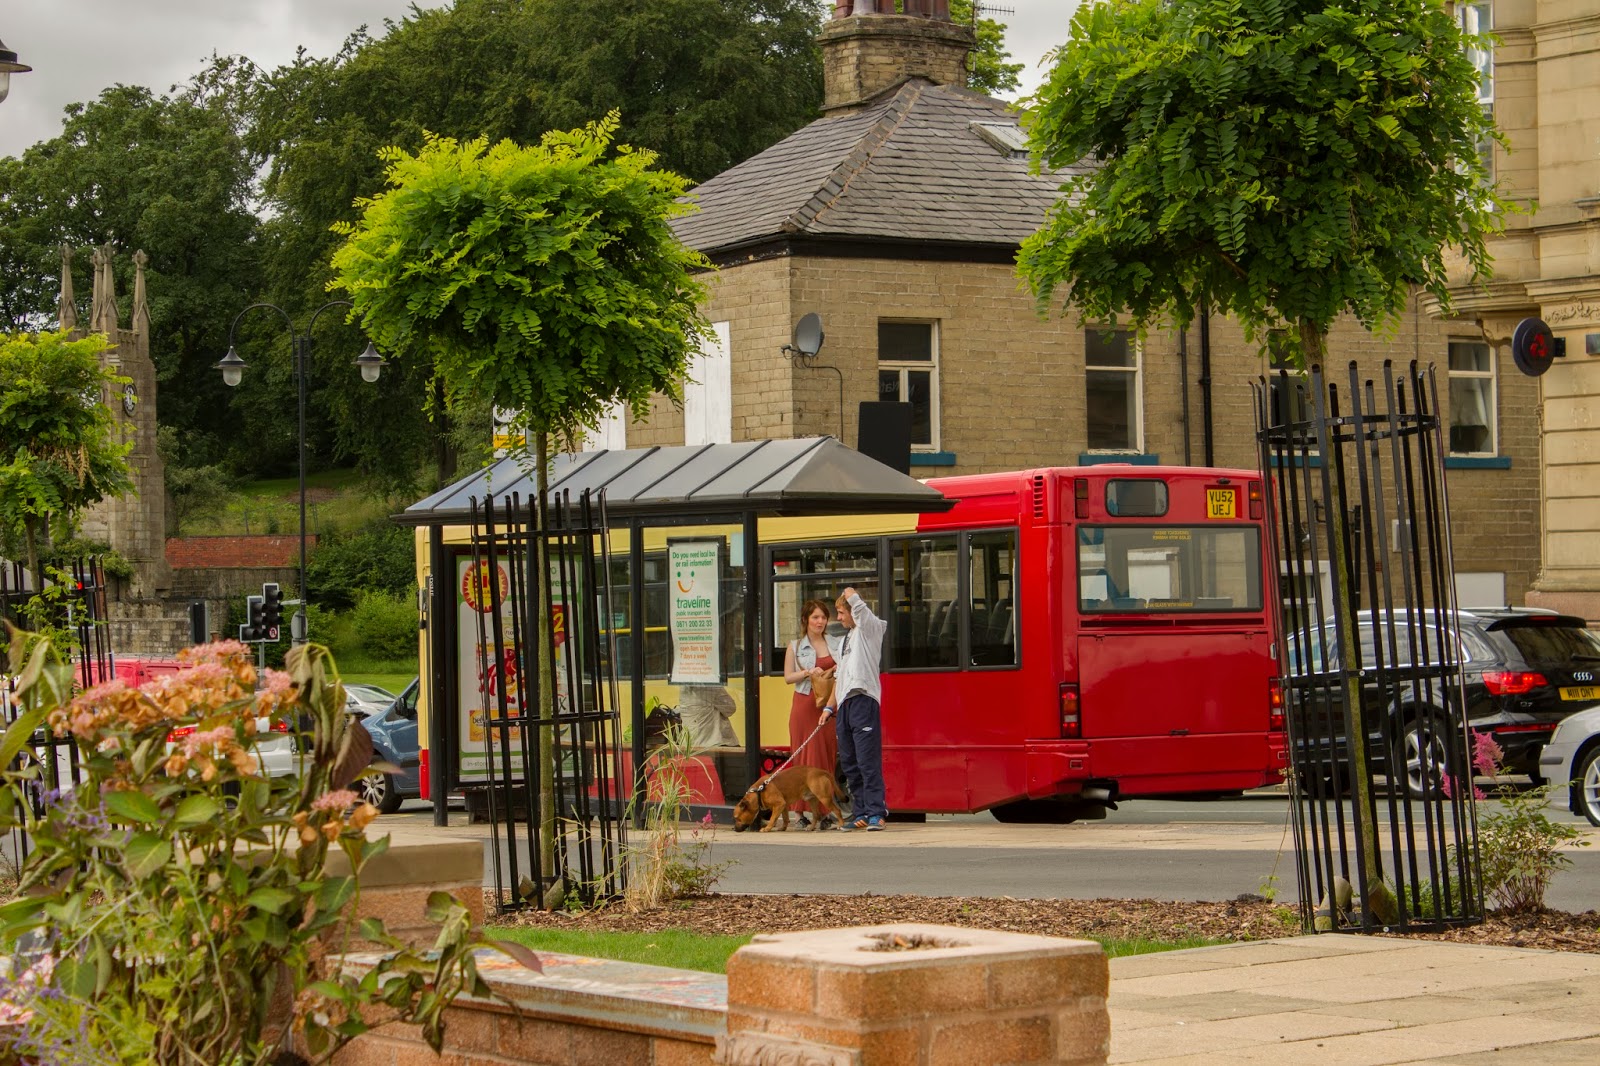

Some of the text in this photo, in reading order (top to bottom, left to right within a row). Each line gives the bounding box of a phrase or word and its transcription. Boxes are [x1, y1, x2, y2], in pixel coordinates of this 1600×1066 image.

[1209, 491, 1233, 504] VU52
[1212, 504, 1231, 516] UEJ
[672, 551, 680, 559] Do
[680, 552, 689, 560] you
[690, 550, 700, 558] need
[700, 550, 709, 558] local
[676, 595, 711, 609] traveline
